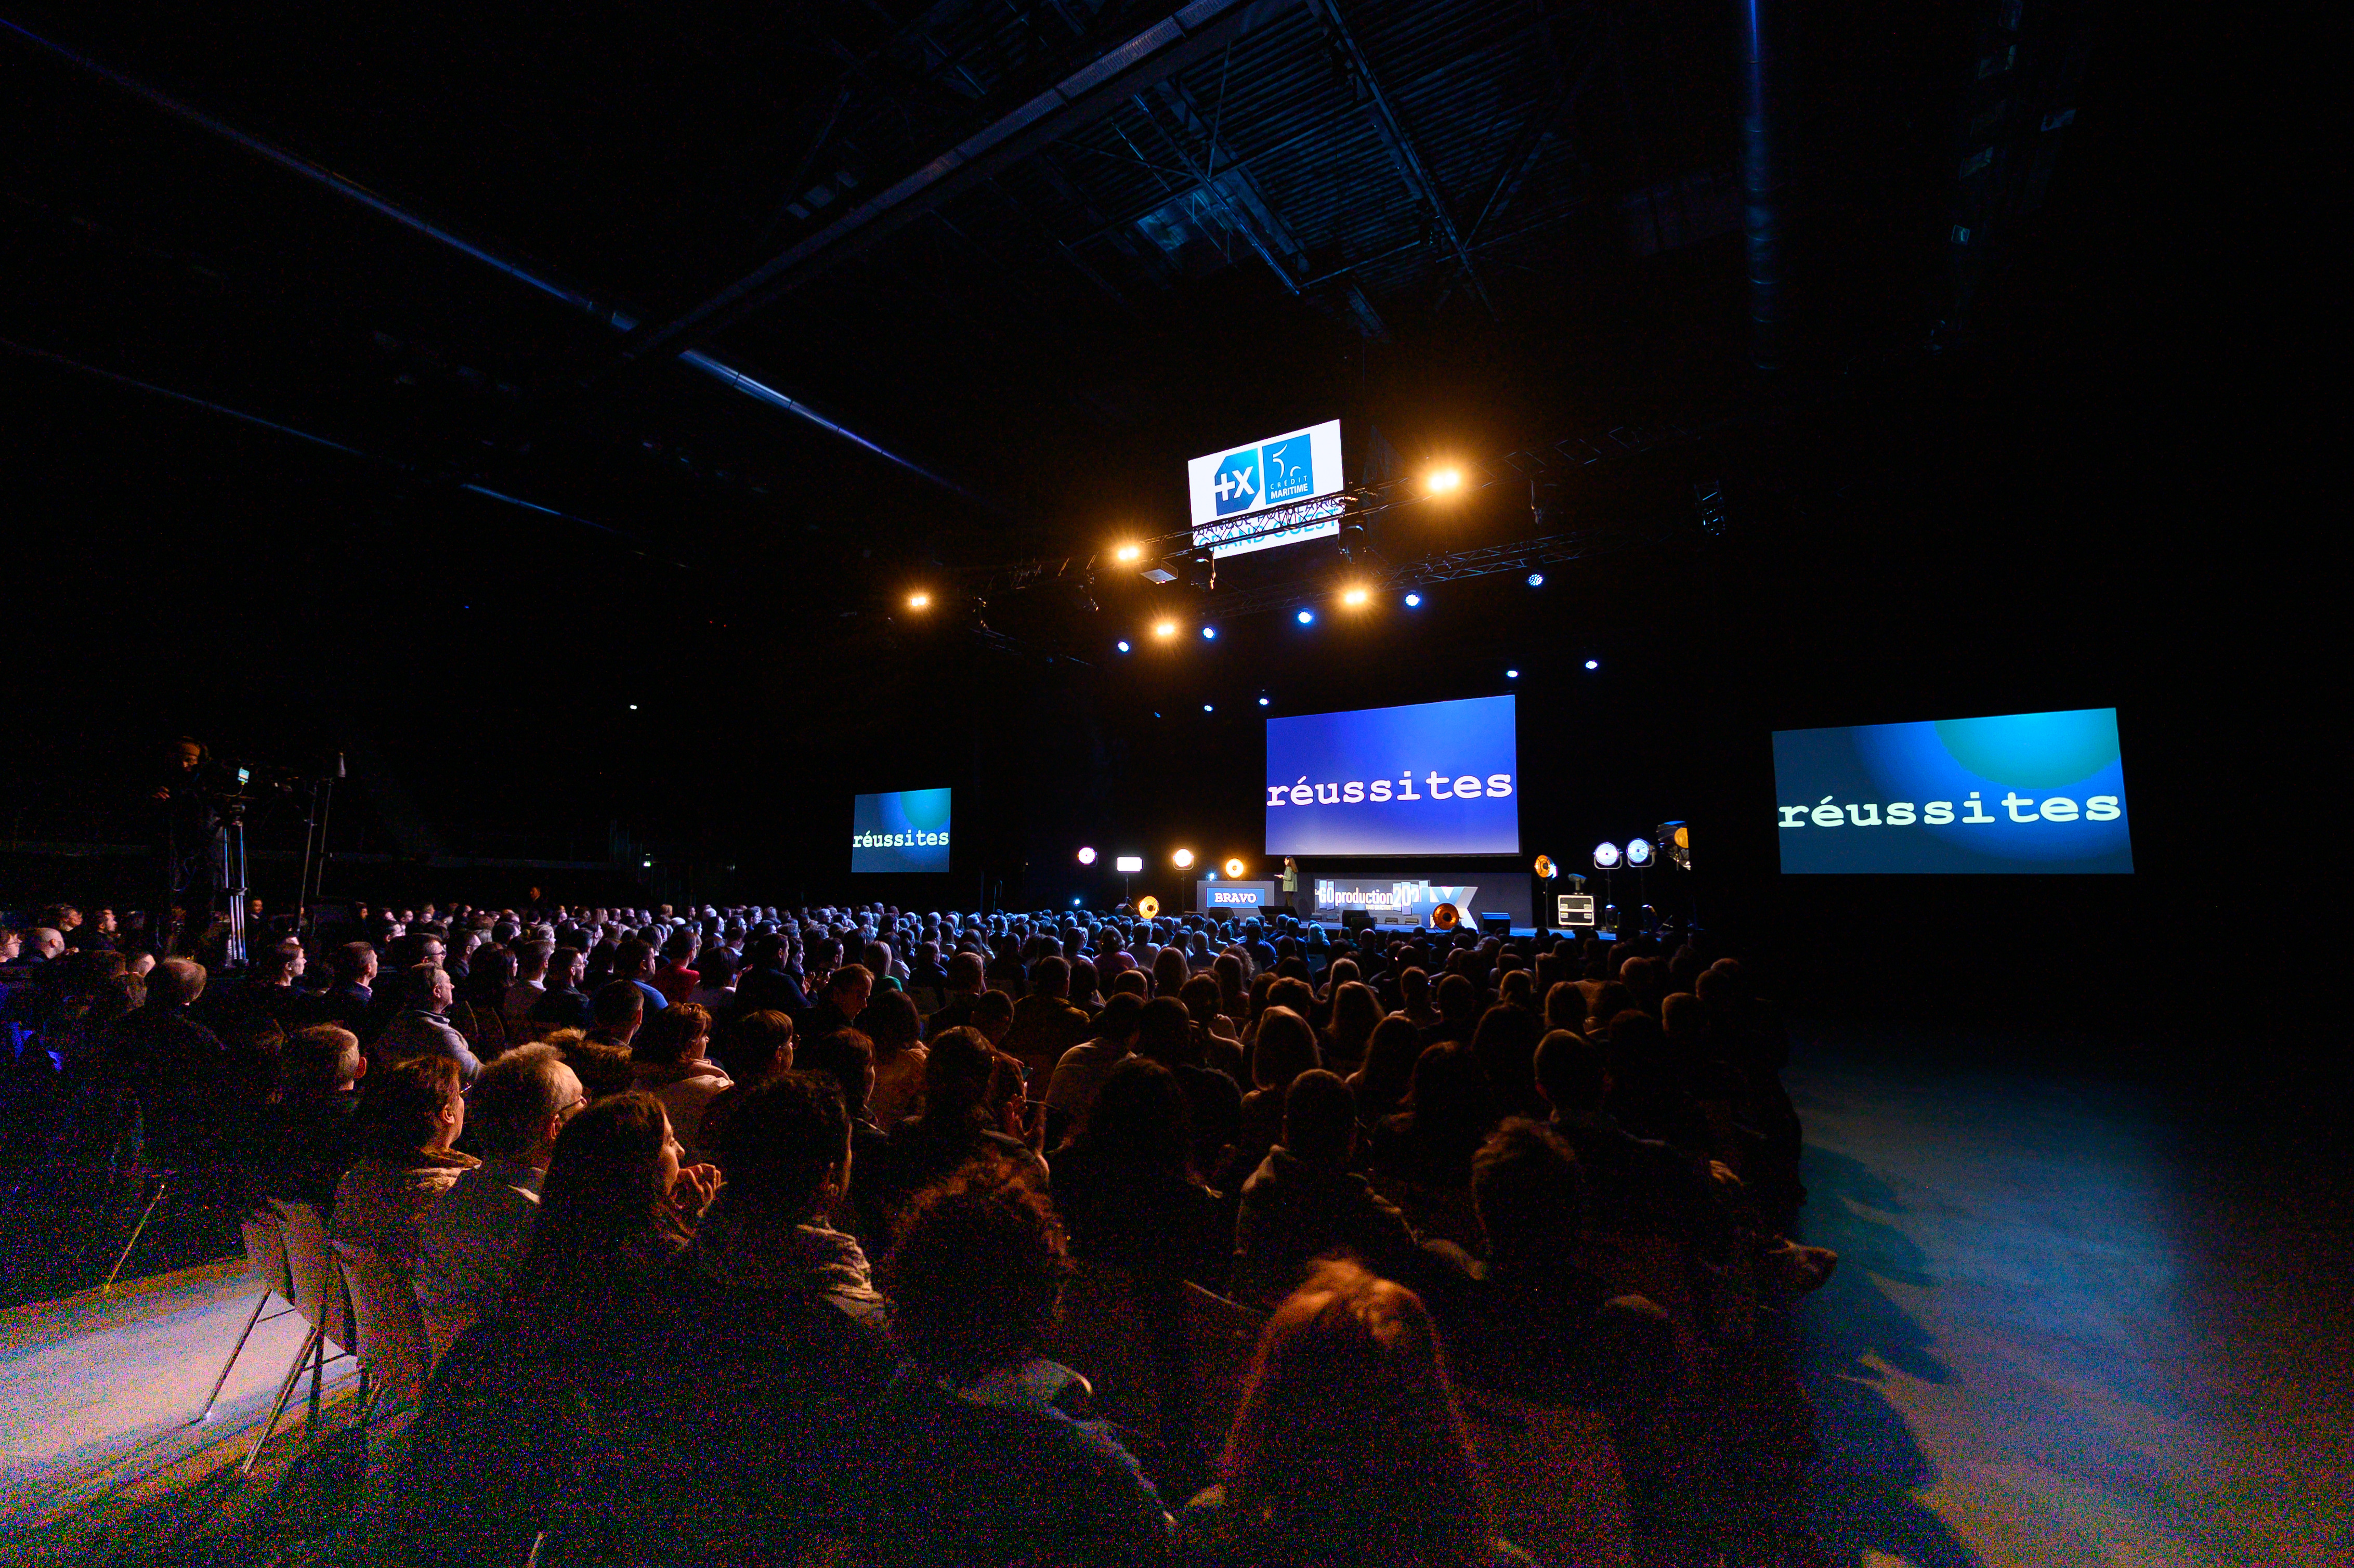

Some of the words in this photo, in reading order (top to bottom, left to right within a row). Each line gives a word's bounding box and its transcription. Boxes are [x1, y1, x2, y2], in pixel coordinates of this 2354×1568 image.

[1270, 475, 1307, 490] CRÉDIT
[1271, 483, 1308, 500] MARITIME
[1267, 771, 1512, 806] réussites
[1778, 792, 2121, 827] réussites
[853, 830, 949, 847] réussites
[1214, 893, 1257, 903] BRAVO
